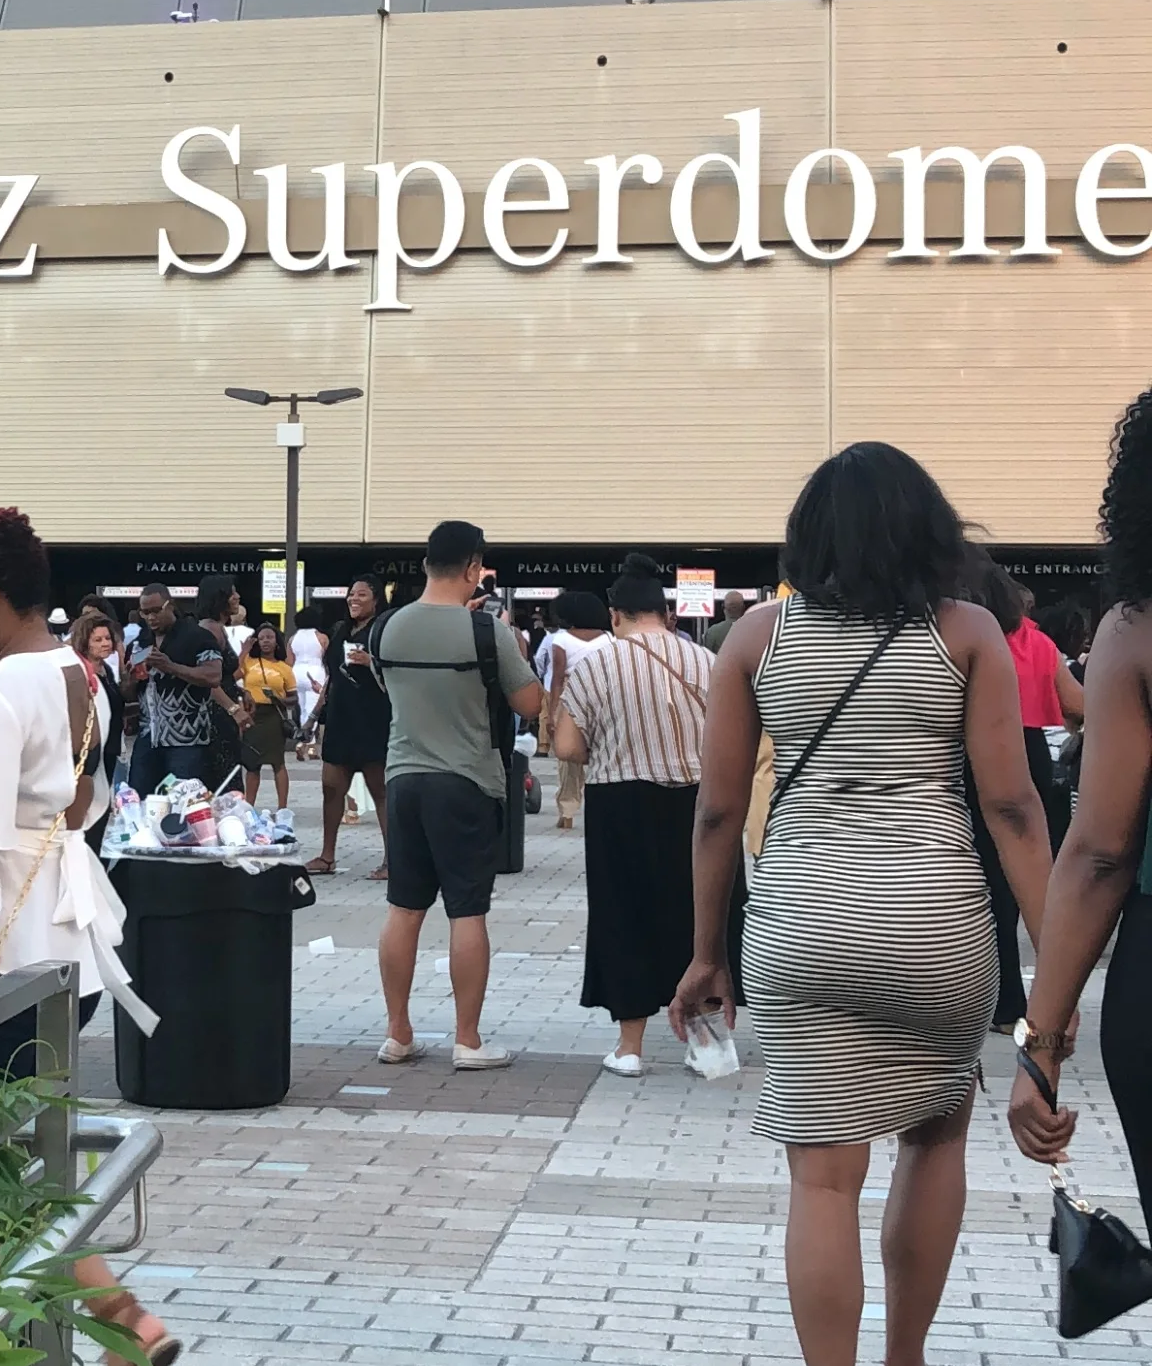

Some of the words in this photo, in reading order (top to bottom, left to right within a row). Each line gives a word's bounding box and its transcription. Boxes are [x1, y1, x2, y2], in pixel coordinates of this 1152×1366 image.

[157, 107, 1152, 311] Superdome
[136, 562, 177, 573] PLAZA
[180, 562, 218, 573] LEVEL
[222, 562, 262, 573] ENTRA
[373, 560, 418, 574] GATE
[517, 562, 560, 573] PLAZA
[565, 562, 605, 573] LEVEL
[1035, 563, 1111, 575] ENTRANCE
